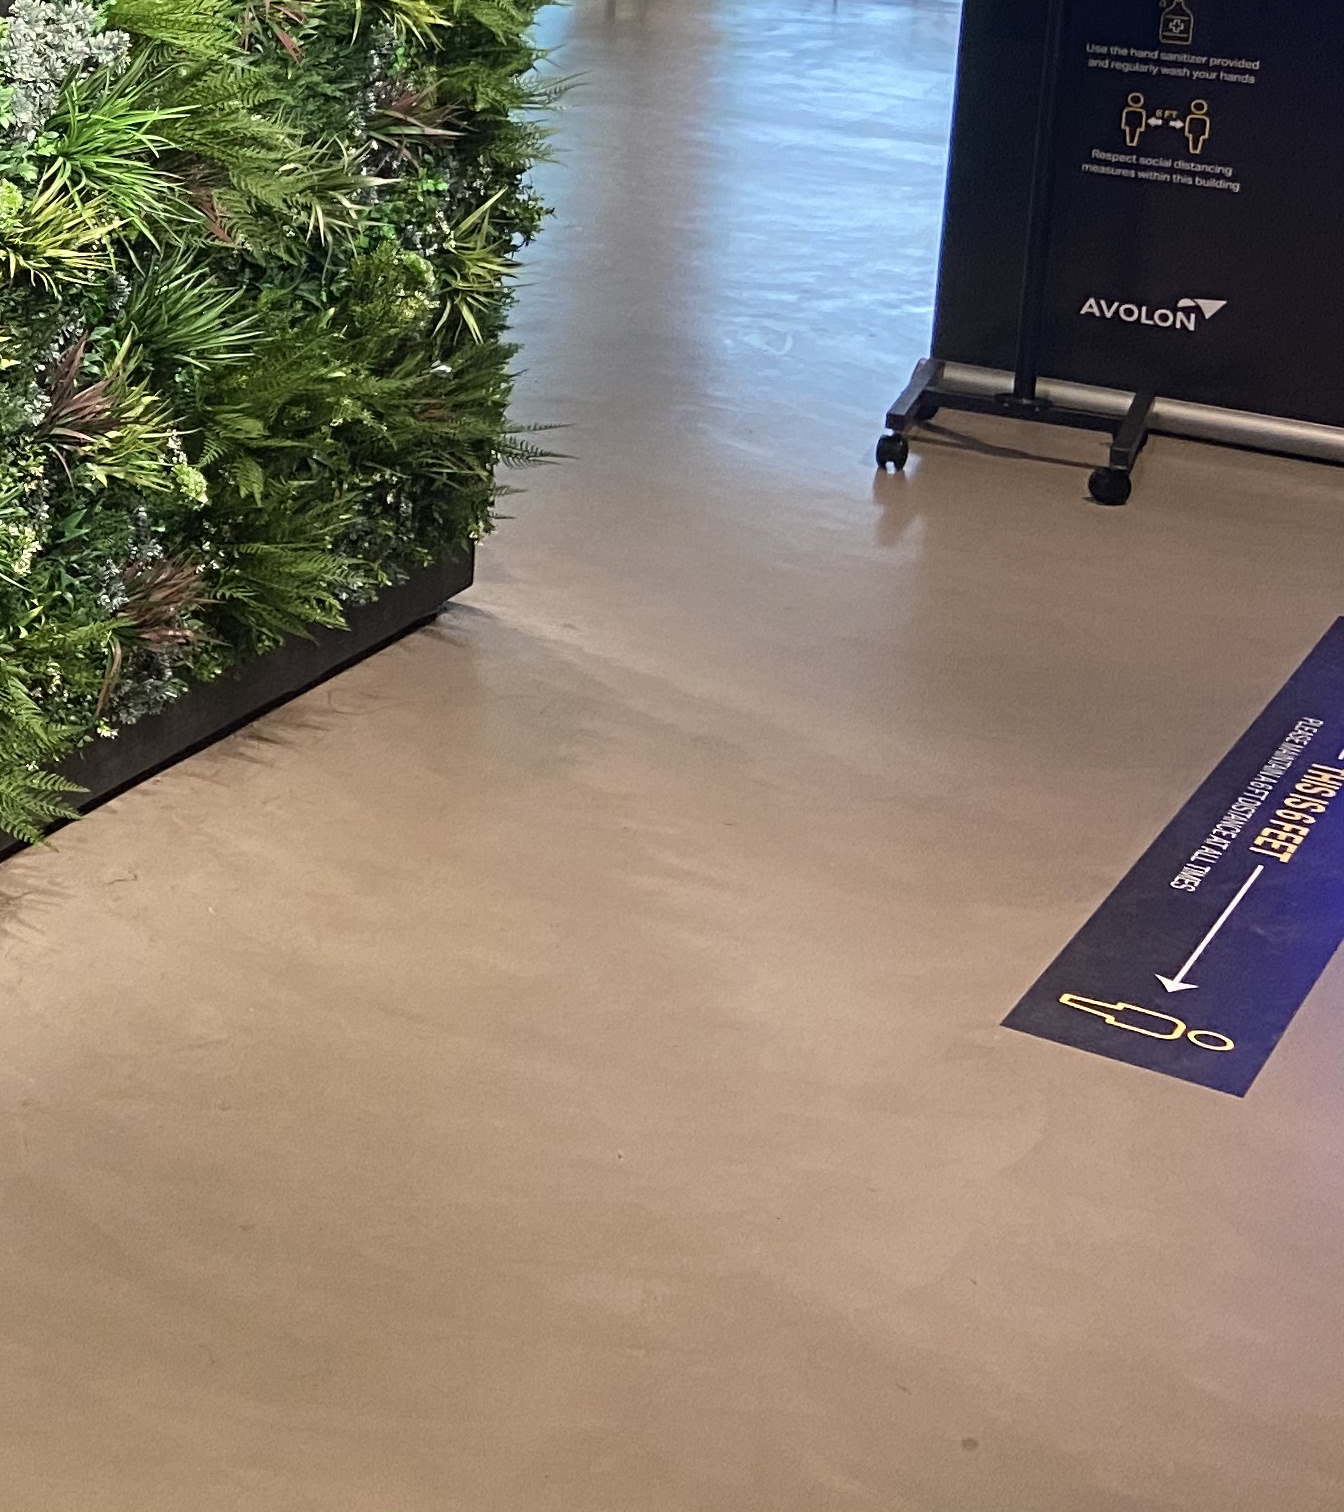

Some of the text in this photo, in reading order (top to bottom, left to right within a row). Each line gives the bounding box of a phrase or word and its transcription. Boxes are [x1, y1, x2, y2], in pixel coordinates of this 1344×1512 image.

[1086, 42, 1261, 70] Use the hand sanitizer provided
[1087, 58, 1256, 84] and regularly wash your hands
[1164, 110, 1179, 119] FT
[1091, 148, 1233, 177] Respect social distancing
[1081, 162, 1241, 193] measures within this building
[1080, 297, 1196, 331] AVOLON
[1285, 716, 1324, 746] PLEASE
[1212, 797, 1262, 839] DISTANCE
[1249, 763, 1344, 863] THIS IS 6 FEET
[1190, 845, 1223, 864] ALL
[1204, 834, 1231, 850] AT
[1170, 863, 1212, 892] TIMES
